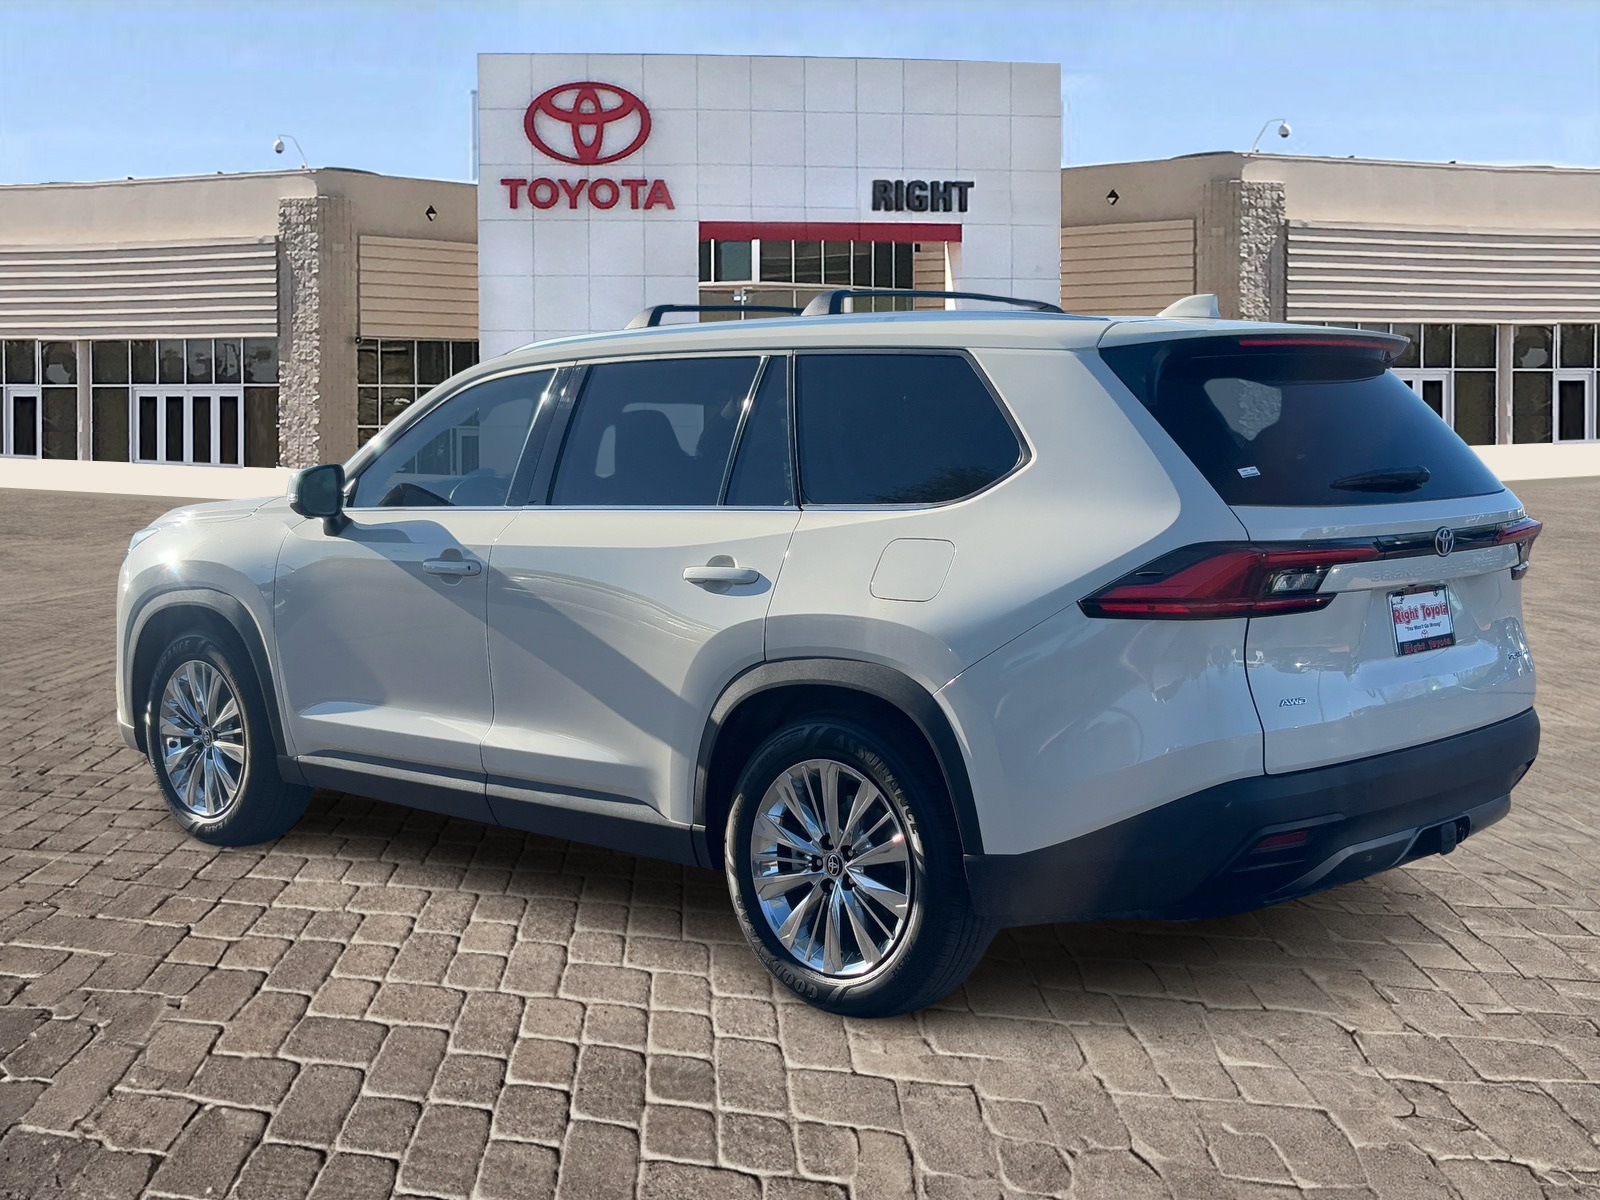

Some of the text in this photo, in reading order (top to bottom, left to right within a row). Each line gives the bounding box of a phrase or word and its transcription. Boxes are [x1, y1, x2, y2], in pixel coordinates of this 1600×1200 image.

[501, 178, 675, 210] TOYOTA
[872, 178, 975, 213] RIGHT
[1393, 601, 1449, 625] Right Toyota
[1404, 637, 1452, 654] Right Toyota
[1279, 697, 1308, 707] AWD
